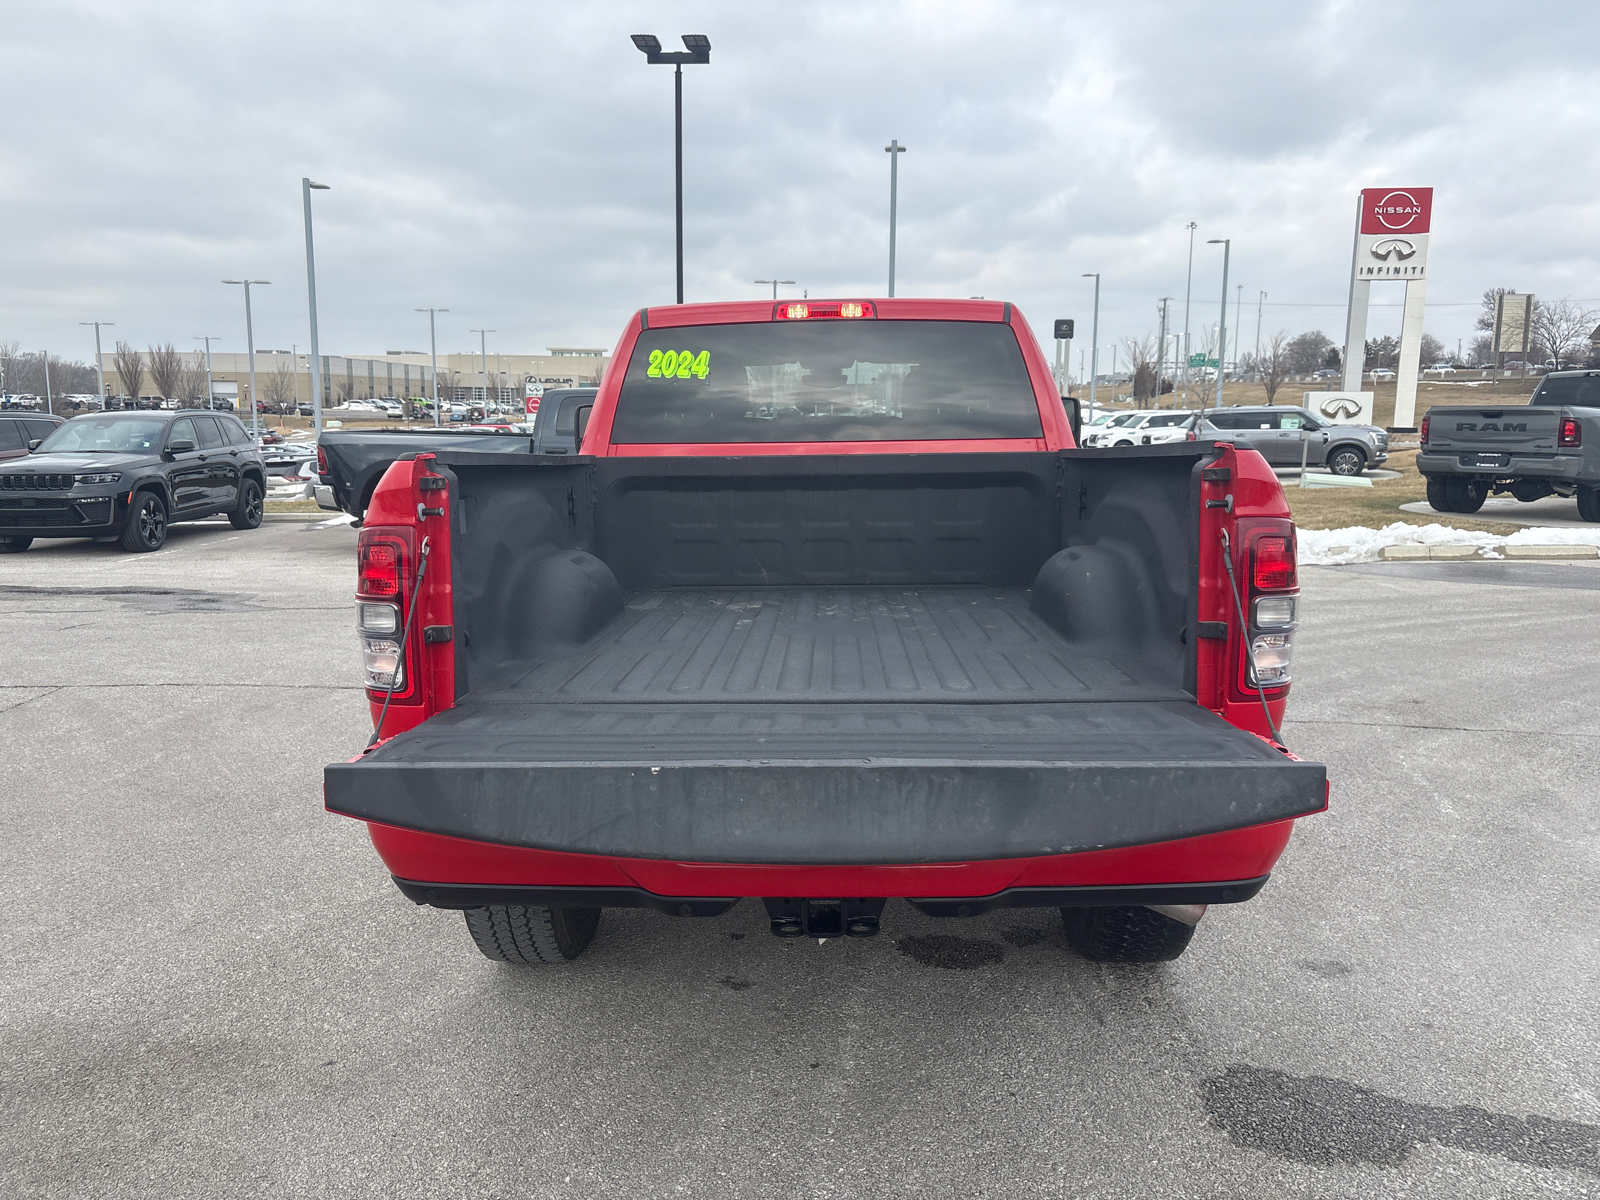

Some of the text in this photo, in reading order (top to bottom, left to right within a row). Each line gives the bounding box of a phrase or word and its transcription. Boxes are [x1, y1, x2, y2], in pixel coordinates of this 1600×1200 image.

[1374, 206, 1421, 214] NISSAN
[1360, 266, 1424, 275] INFINITI
[647, 349, 710, 380] 2024
[1456, 423, 1527, 432] RAM
